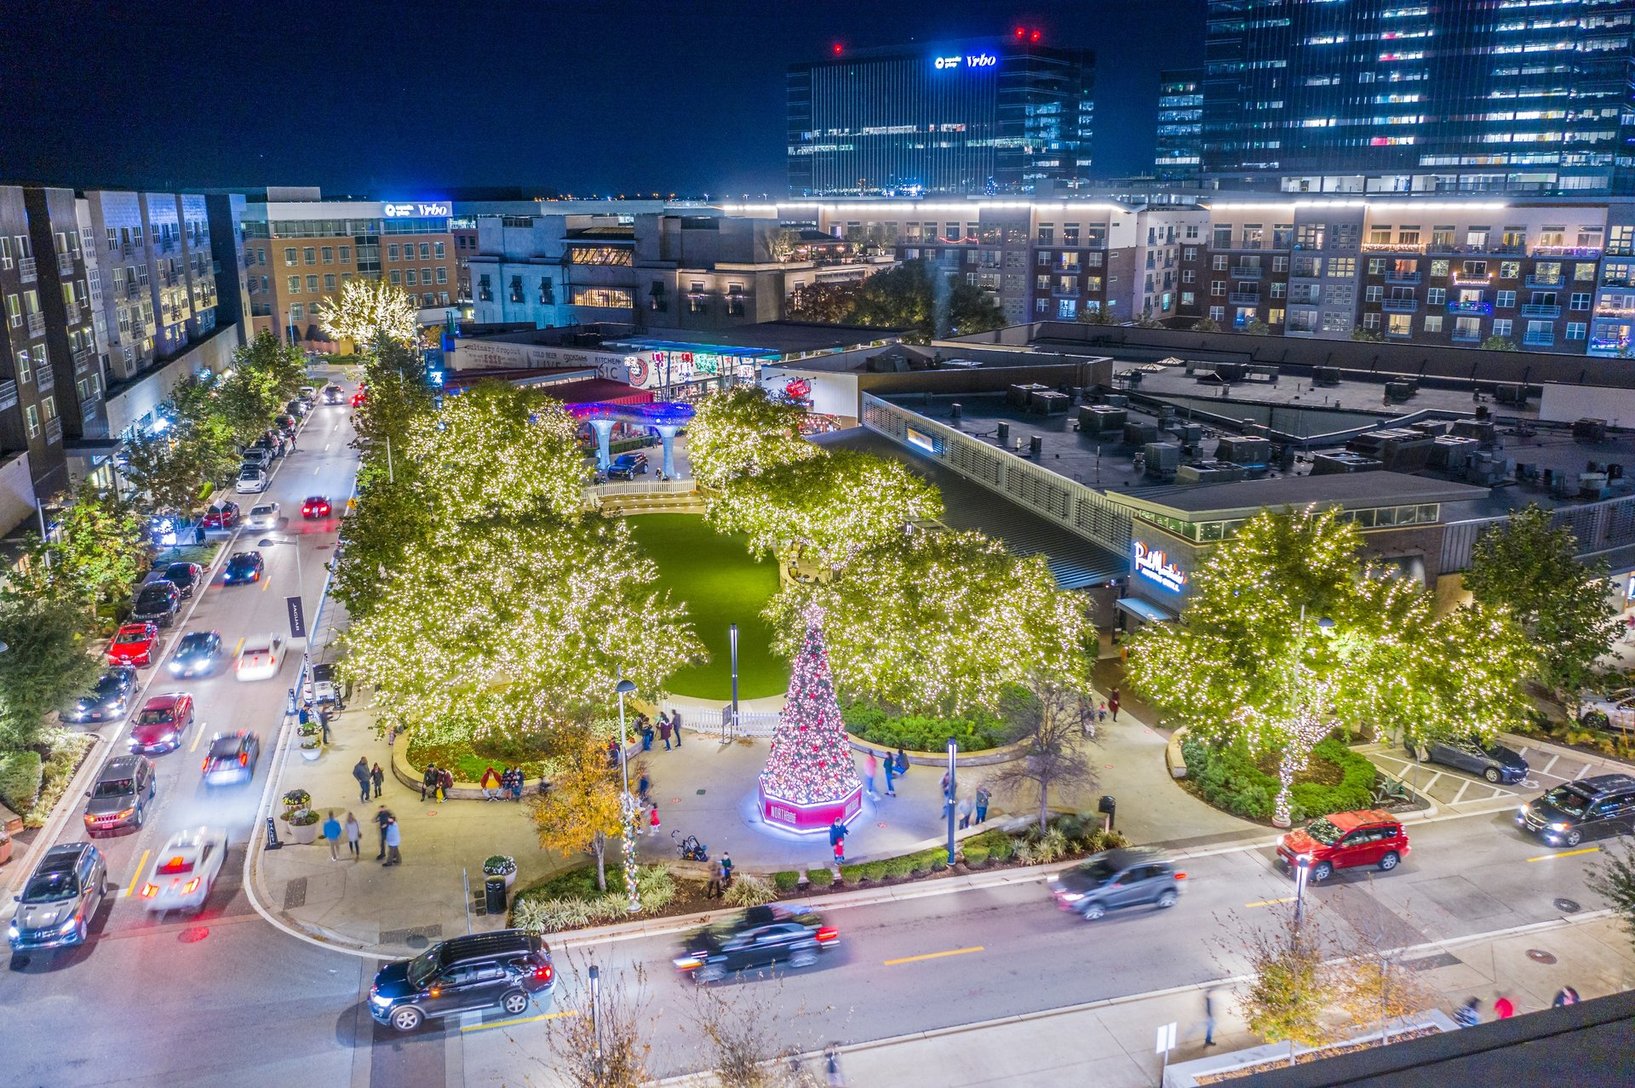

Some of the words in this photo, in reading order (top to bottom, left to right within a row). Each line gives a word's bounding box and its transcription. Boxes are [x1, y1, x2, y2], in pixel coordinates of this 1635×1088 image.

[966, 53, 997, 68] Vrbo
[418, 203, 448, 217] Vrbo
[545, 351, 557, 359] BEER
[292, 603, 300, 631] JAGUAR
